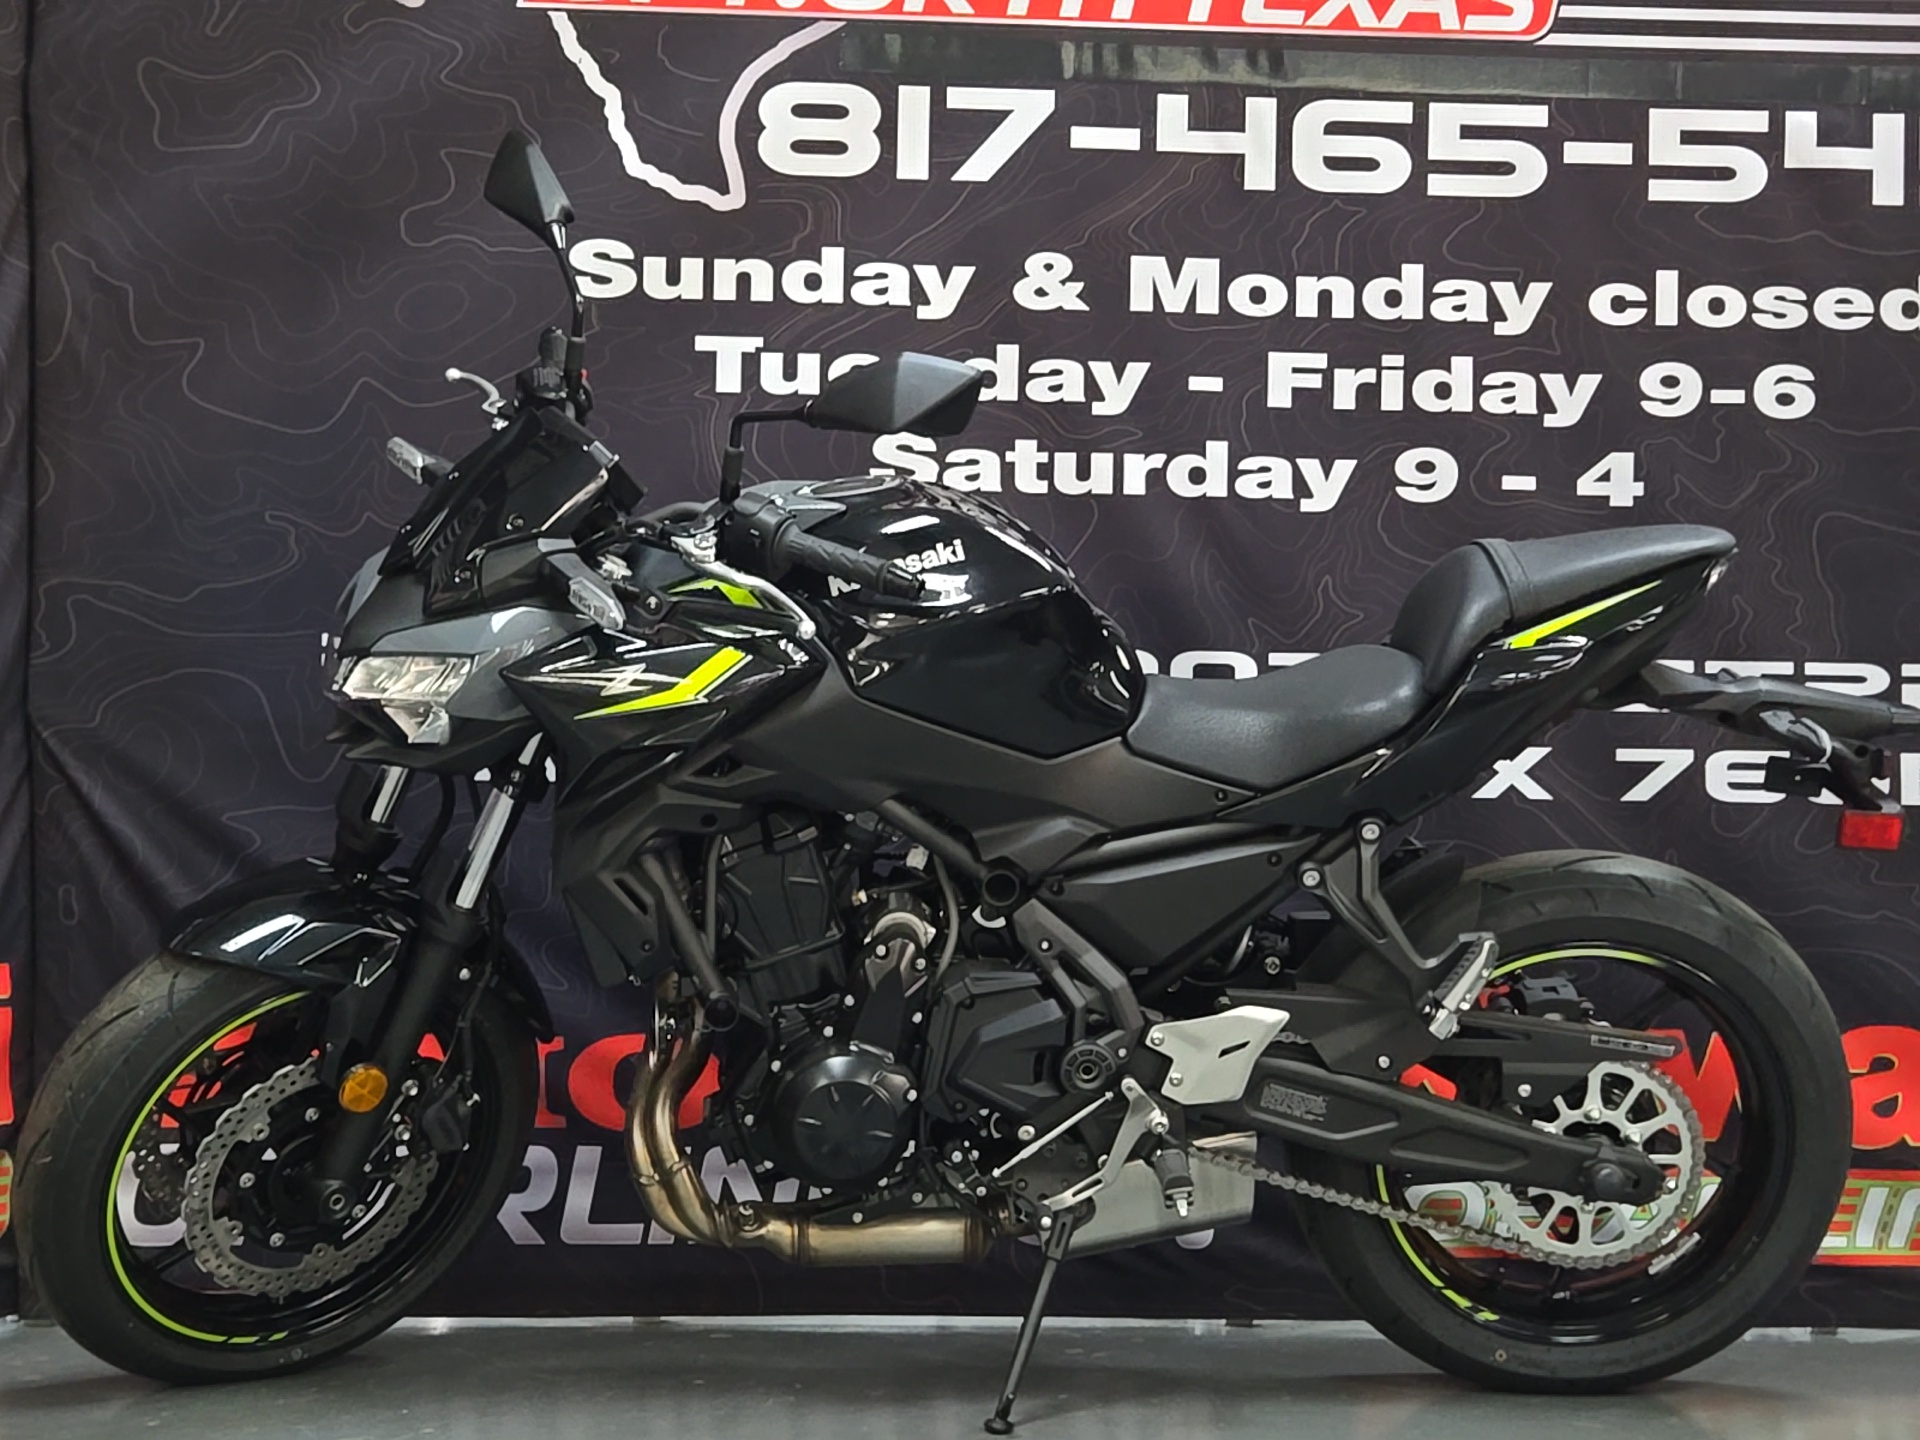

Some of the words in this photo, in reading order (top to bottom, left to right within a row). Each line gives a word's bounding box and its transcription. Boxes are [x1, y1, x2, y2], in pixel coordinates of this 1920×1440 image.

[566, 237, 976, 320] Sunday
[1012, 252, 1090, 312] &
[1129, 255, 1553, 336] Monday
[694, 335, 1151, 416] Tuday
[1188, 375, 1224, 392] -
[1267, 351, 1603, 428] Friday
[1639, 361, 1816, 420] 9-6
[869, 431, 1358, 513] Saturday
[1394, 447, 1459, 503] 9
[1501, 475, 1537, 491] -
[1576, 451, 1645, 507] 4
